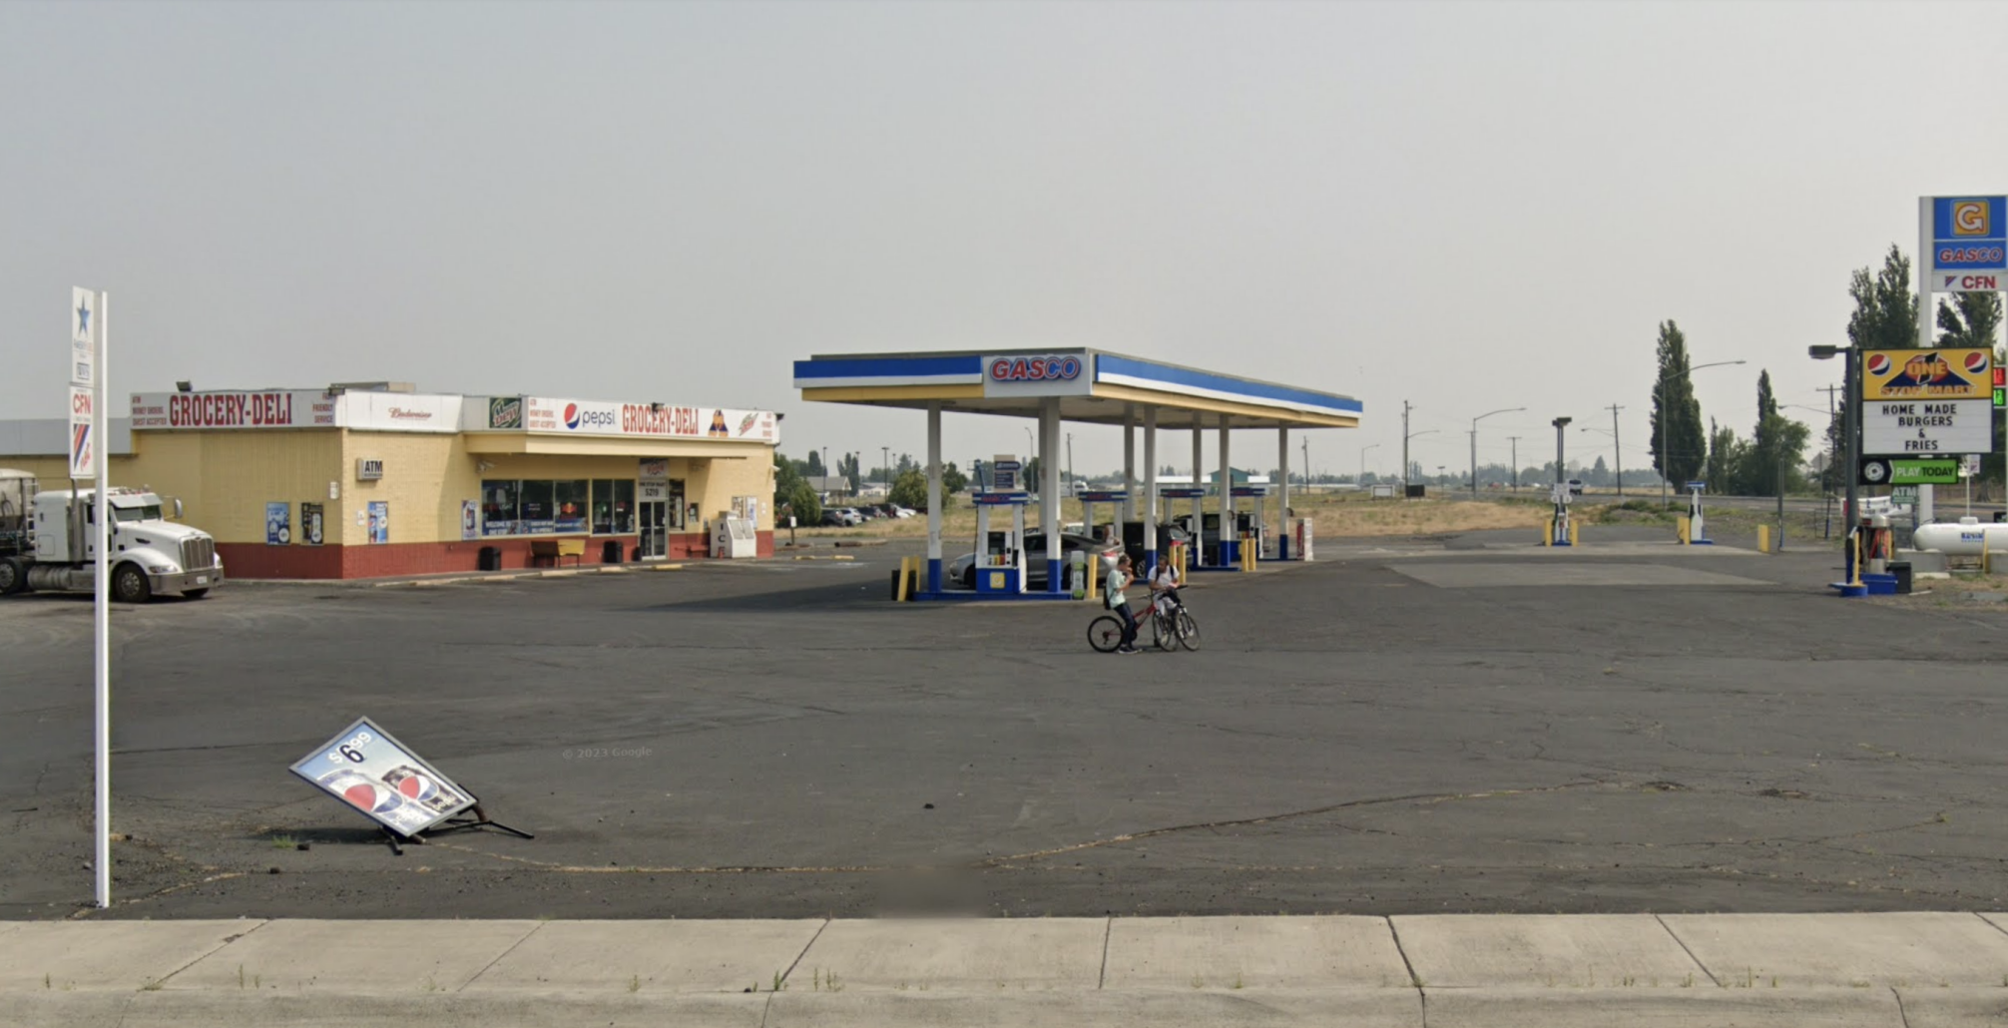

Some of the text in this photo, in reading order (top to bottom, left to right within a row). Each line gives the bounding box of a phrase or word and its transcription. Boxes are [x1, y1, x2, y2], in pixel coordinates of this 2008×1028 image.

[1939, 247, 2003, 262] GASCO
[1962, 276, 1996, 289] CFN
[989, 357, 1081, 380] GASCO
[1907, 361, 1947, 375] ONE
[73, 394, 91, 414] CFN
[169, 393, 292, 426] GROCERY-DELI
[1883, 404, 1957, 415] HOME MADE
[388, 407, 432, 418] Budweiser
[582, 409, 616, 428] pepsi
[622, 404, 699, 434] GROCERY-DELI
[1899, 416, 1953, 426] BURGERS
[1918, 428, 1925, 438] &
[1905, 440, 1938, 450] FRIES
[364, 460, 383, 472] ATM
[1896, 467, 1953, 477] PLAY TODAY
[1892, 486, 1917, 497] ATM
